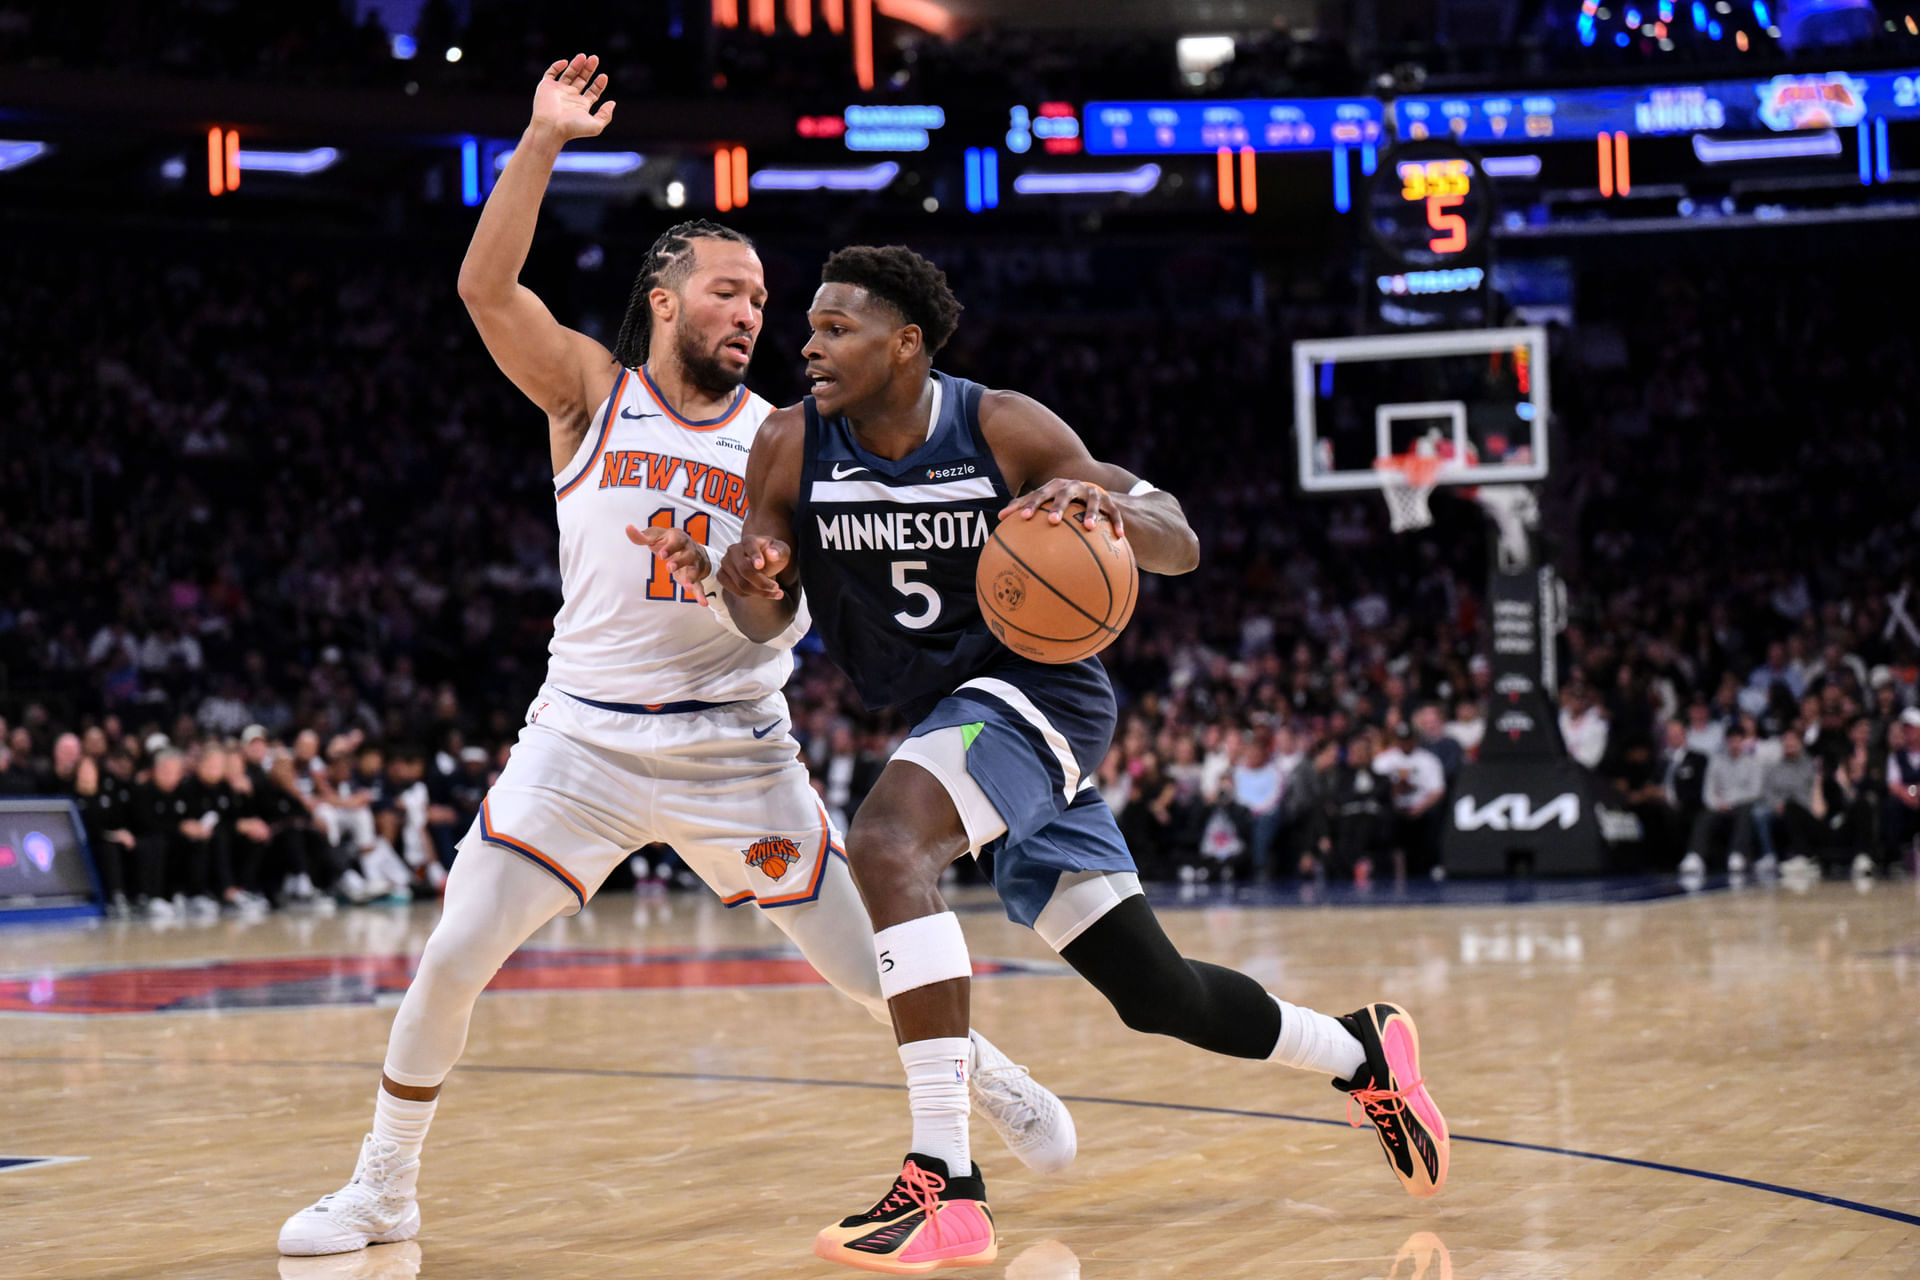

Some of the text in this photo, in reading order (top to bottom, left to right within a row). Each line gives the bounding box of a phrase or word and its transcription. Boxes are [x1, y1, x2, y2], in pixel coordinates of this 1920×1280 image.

[1426, 194, 1467, 254] 5
[715, 440, 733, 449] abu
[599, 450, 682, 491] NEW
[935, 464, 975, 479] sezzle
[816, 510, 989, 551] MINNESOTA
[890, 560, 942, 630] 5
[1454, 793, 1580, 831] KIA
[746, 838, 801, 865] KNICKS
[879, 950, 895, 973] 5
